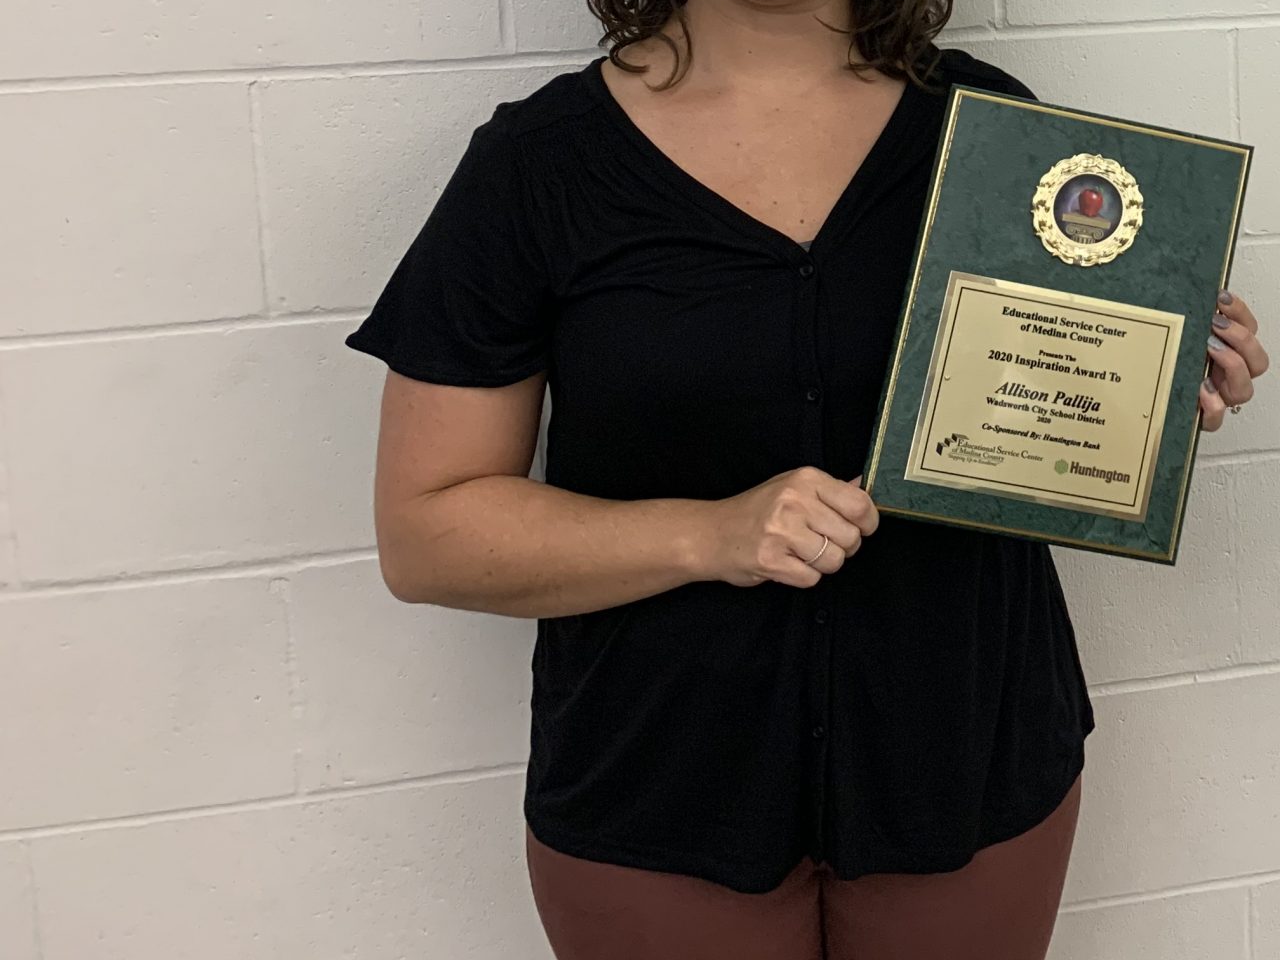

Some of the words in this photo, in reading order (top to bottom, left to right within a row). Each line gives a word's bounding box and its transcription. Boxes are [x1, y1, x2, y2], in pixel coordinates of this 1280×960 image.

[1002, 306, 1058, 325] Educational
[1060, 317, 1093, 332] Service
[1095, 324, 1127, 338] Center
[1020, 323, 1032, 332] of
[1032, 324, 1067, 339] Medina
[1070, 332, 1104, 347] County
[988, 350, 1013, 363] 2020
[1015, 354, 1071, 374] Inspiration
[1072, 366, 1106, 380] Award
[1109, 371, 1122, 383] To
[1039, 349, 1063, 360] Presents
[1065, 354, 1077, 362] The
[995, 381, 1049, 402] Allison
[1051, 390, 1101, 413] Pallija
[986, 397, 1030, 412] Wadsworth
[1031, 405, 1048, 416] City
[1049, 408, 1075, 420] School
[1077, 413, 1106, 426] District
[1036, 415, 1052, 424] 2020
[982, 423, 1029, 438] Co-Sponsored
[1030, 431, 1042, 441] By:
[1043, 434, 1082, 447] Huntington
[1083, 441, 1101, 450] Bank
[957, 439, 996, 453] Educational
[997, 445, 1020, 457] Service
[1020, 449, 1044, 462] Center
[959, 448, 982, 458] Medina
[983, 452, 1005, 463] County
[1070, 460, 1131, 484] Huntington
